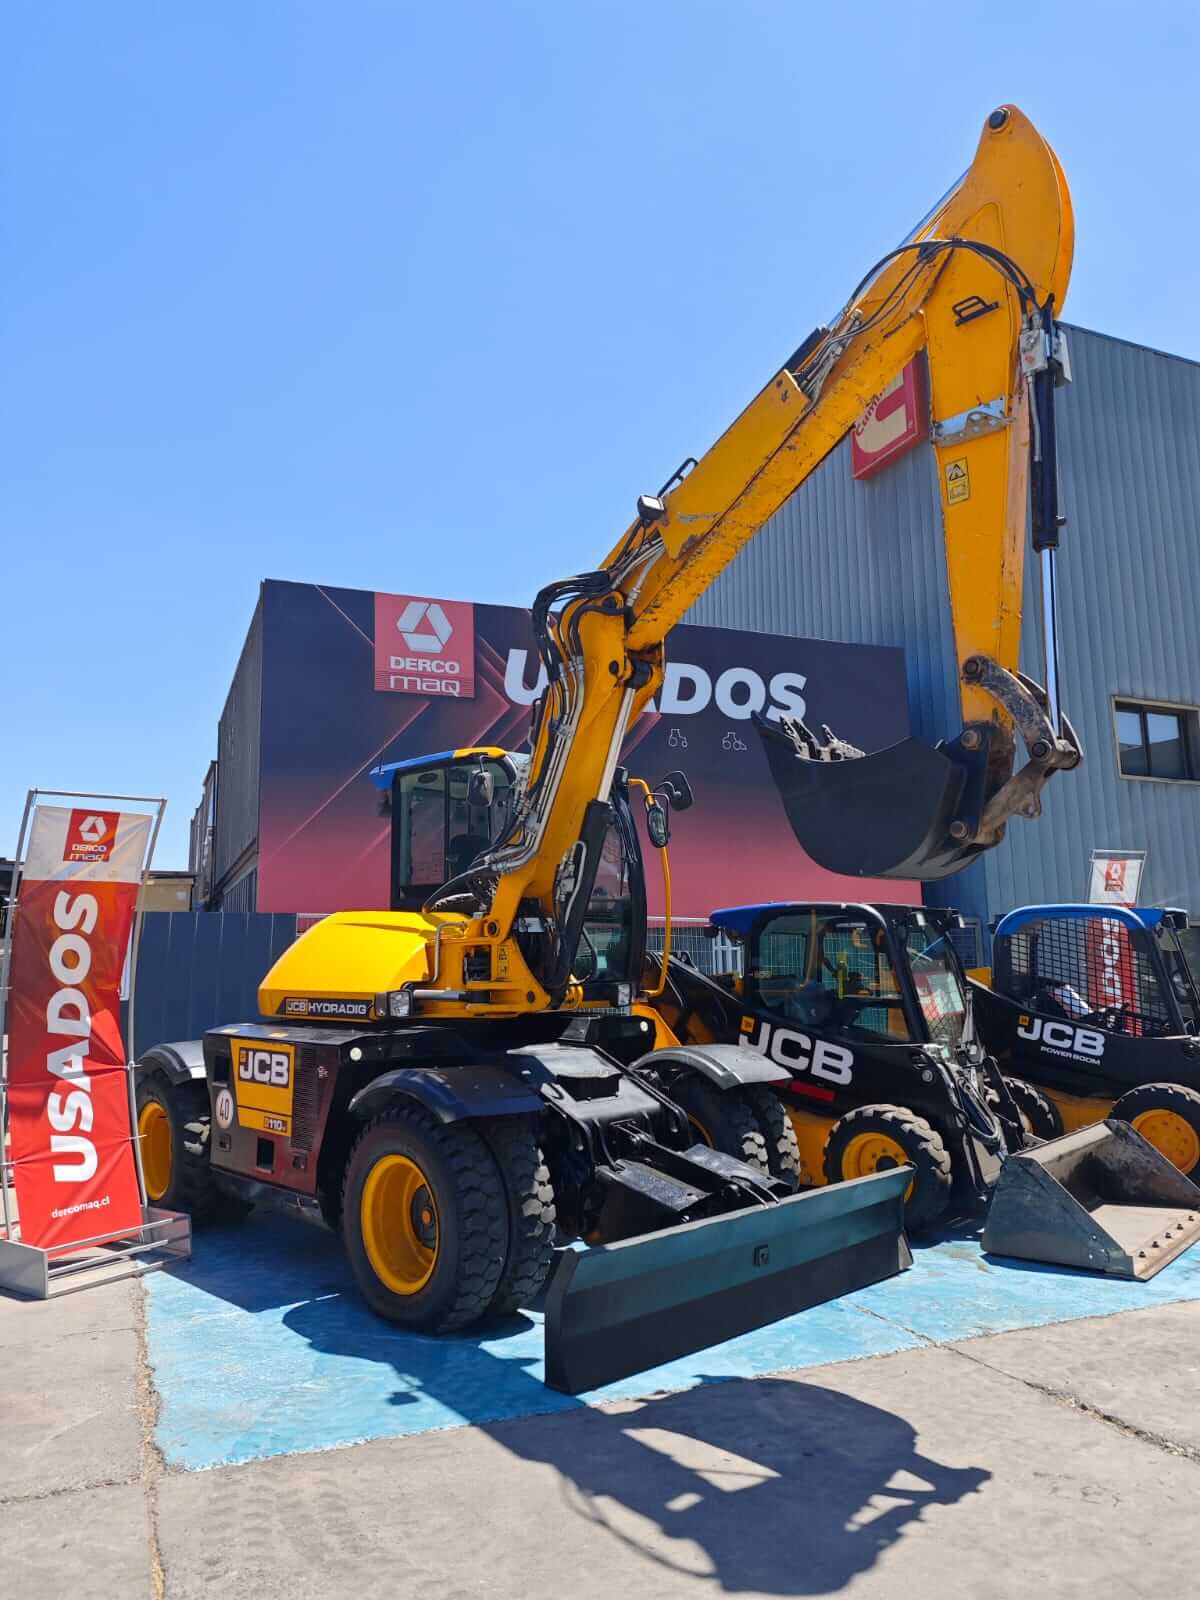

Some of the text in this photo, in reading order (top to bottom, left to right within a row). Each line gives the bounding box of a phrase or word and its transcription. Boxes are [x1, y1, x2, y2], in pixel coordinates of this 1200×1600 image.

[390, 656, 460, 674] DERCO
[504, 648, 807, 723] UDOS
[287, 1001, 367, 1015] JCB HYDRADIG
[46, 890, 99, 1182] USADOS
[738, 1021, 854, 1085] JCB
[1017, 1018, 1105, 1056] JCB
[239, 1050, 289, 1085] JCB
[218, 1096, 230, 1121] 40
[51, 1195, 111, 1219] dercomaq.cl
